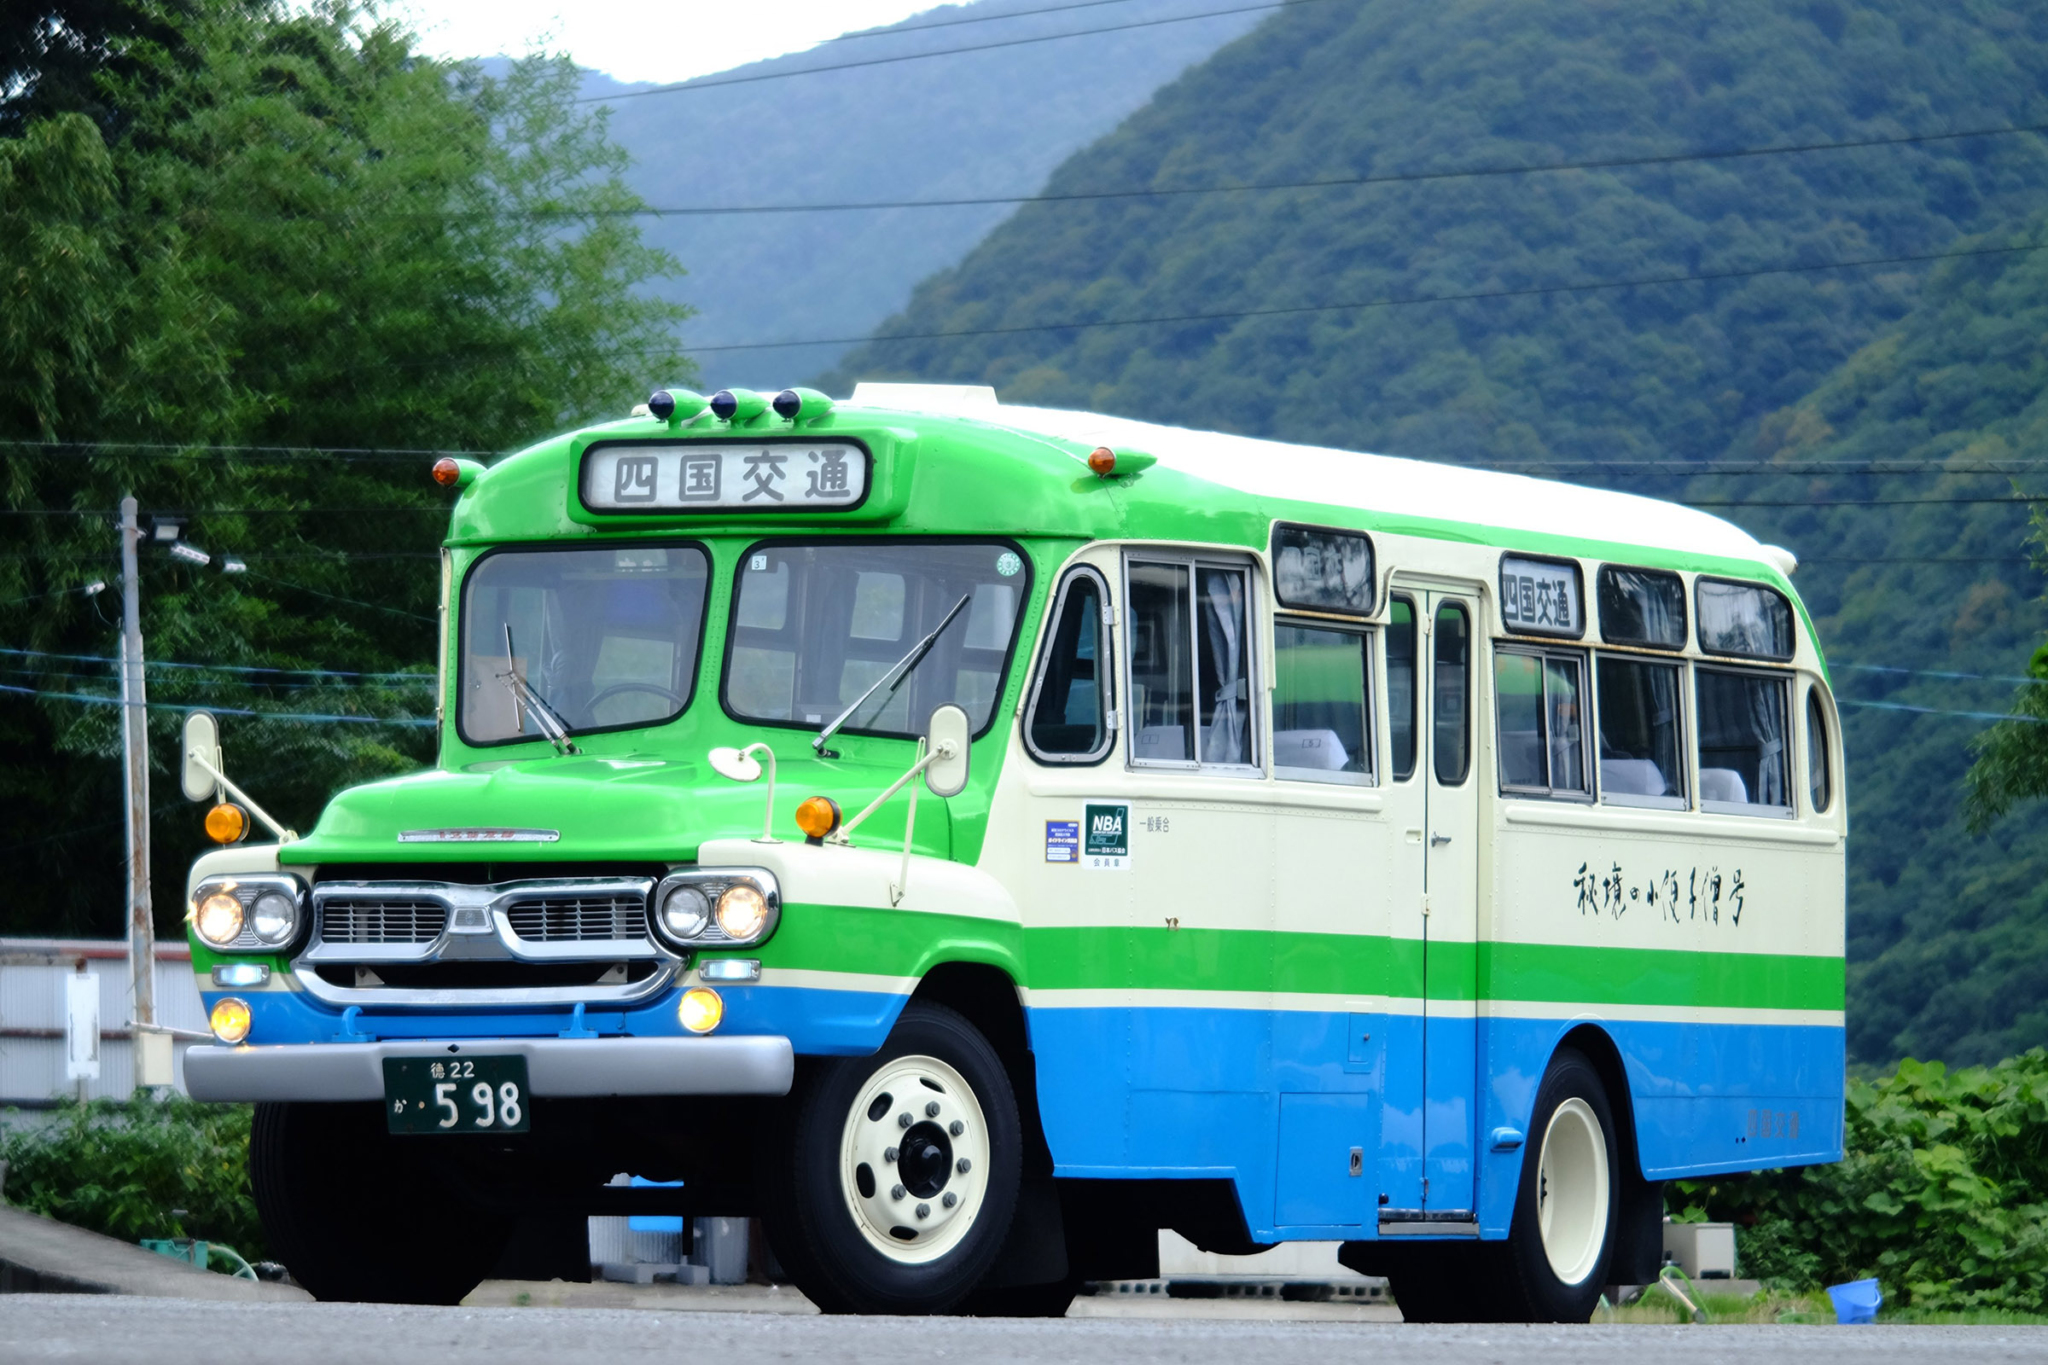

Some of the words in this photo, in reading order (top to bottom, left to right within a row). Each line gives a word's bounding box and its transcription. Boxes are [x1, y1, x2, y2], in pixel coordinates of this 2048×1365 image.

[614, 450, 851, 503] 四国交通
[1503, 573, 1571, 627] 四国交通
[1092, 815, 1122, 832] NBA
[1139, 816, 1170, 833] 一般乗合
[1747, 1109, 1799, 1139] 四国交通
